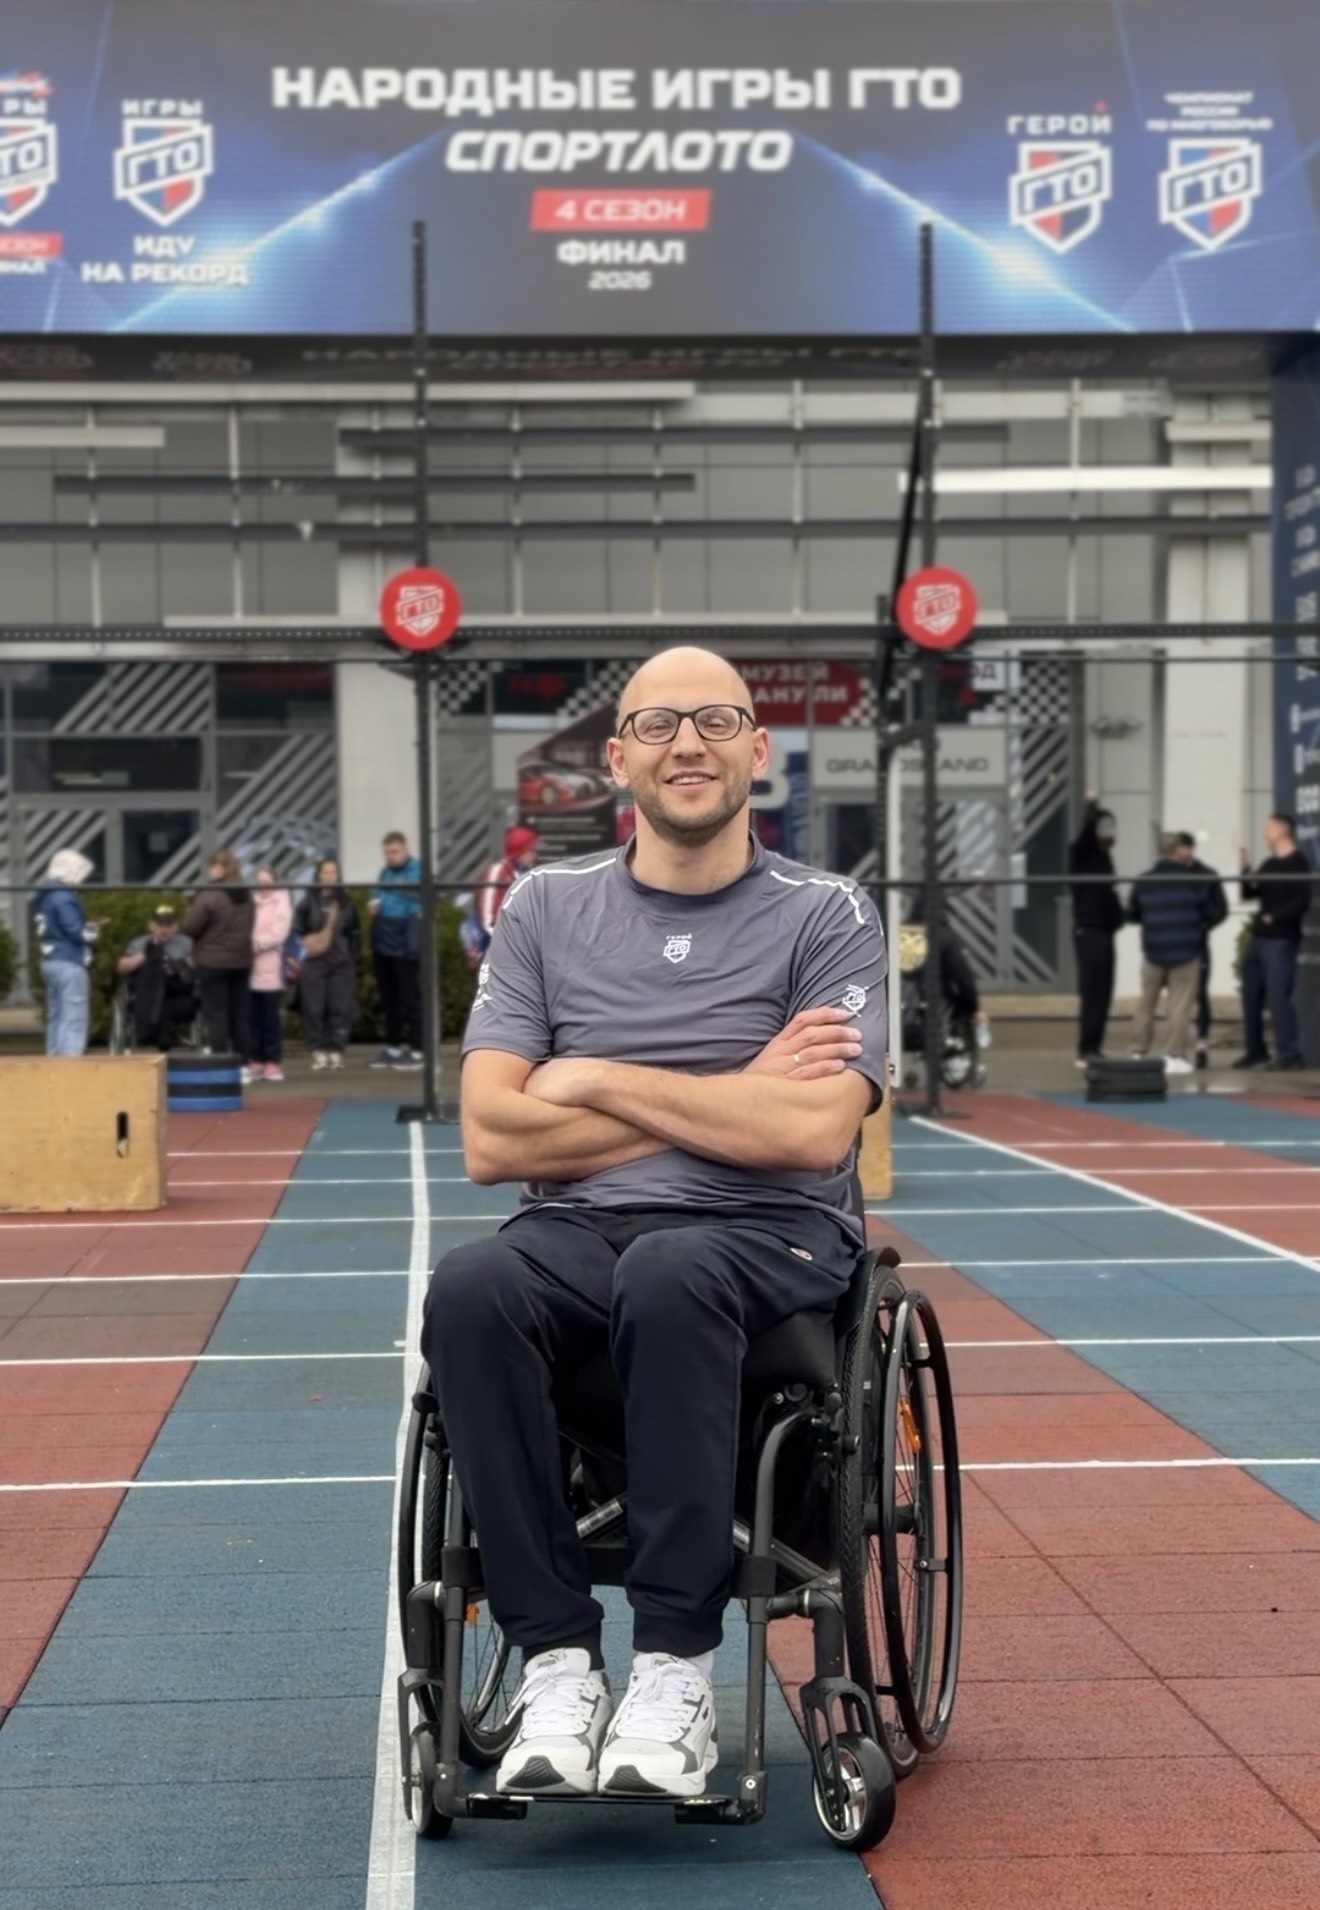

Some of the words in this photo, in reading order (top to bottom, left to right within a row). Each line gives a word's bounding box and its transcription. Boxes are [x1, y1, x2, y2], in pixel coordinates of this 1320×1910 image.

[272, 67, 635, 116] НАРОДНЫЕ
[653, 67, 830, 109] ИГРЫ
[850, 67, 961, 109] ГТО
[0, 100, 46, 115] РЫ
[122, 99, 204, 116] ИГРЫ
[1007, 101, 1112, 134] ГЕРОЙ
[127, 140, 200, 186] ГТО
[445, 130, 793, 172] СПОРТЛОТО
[1023, 164, 1098, 212] ГТО
[1174, 160, 1248, 209] ГТО
[555, 200, 576, 220] 4
[584, 199, 687, 221] СЕЗОН
[134, 235, 196, 257] ИДУ
[557, 240, 686, 265] ФИНАЛ
[82, 263, 124, 283] НА
[132, 263, 249, 285] РЕКОРД
